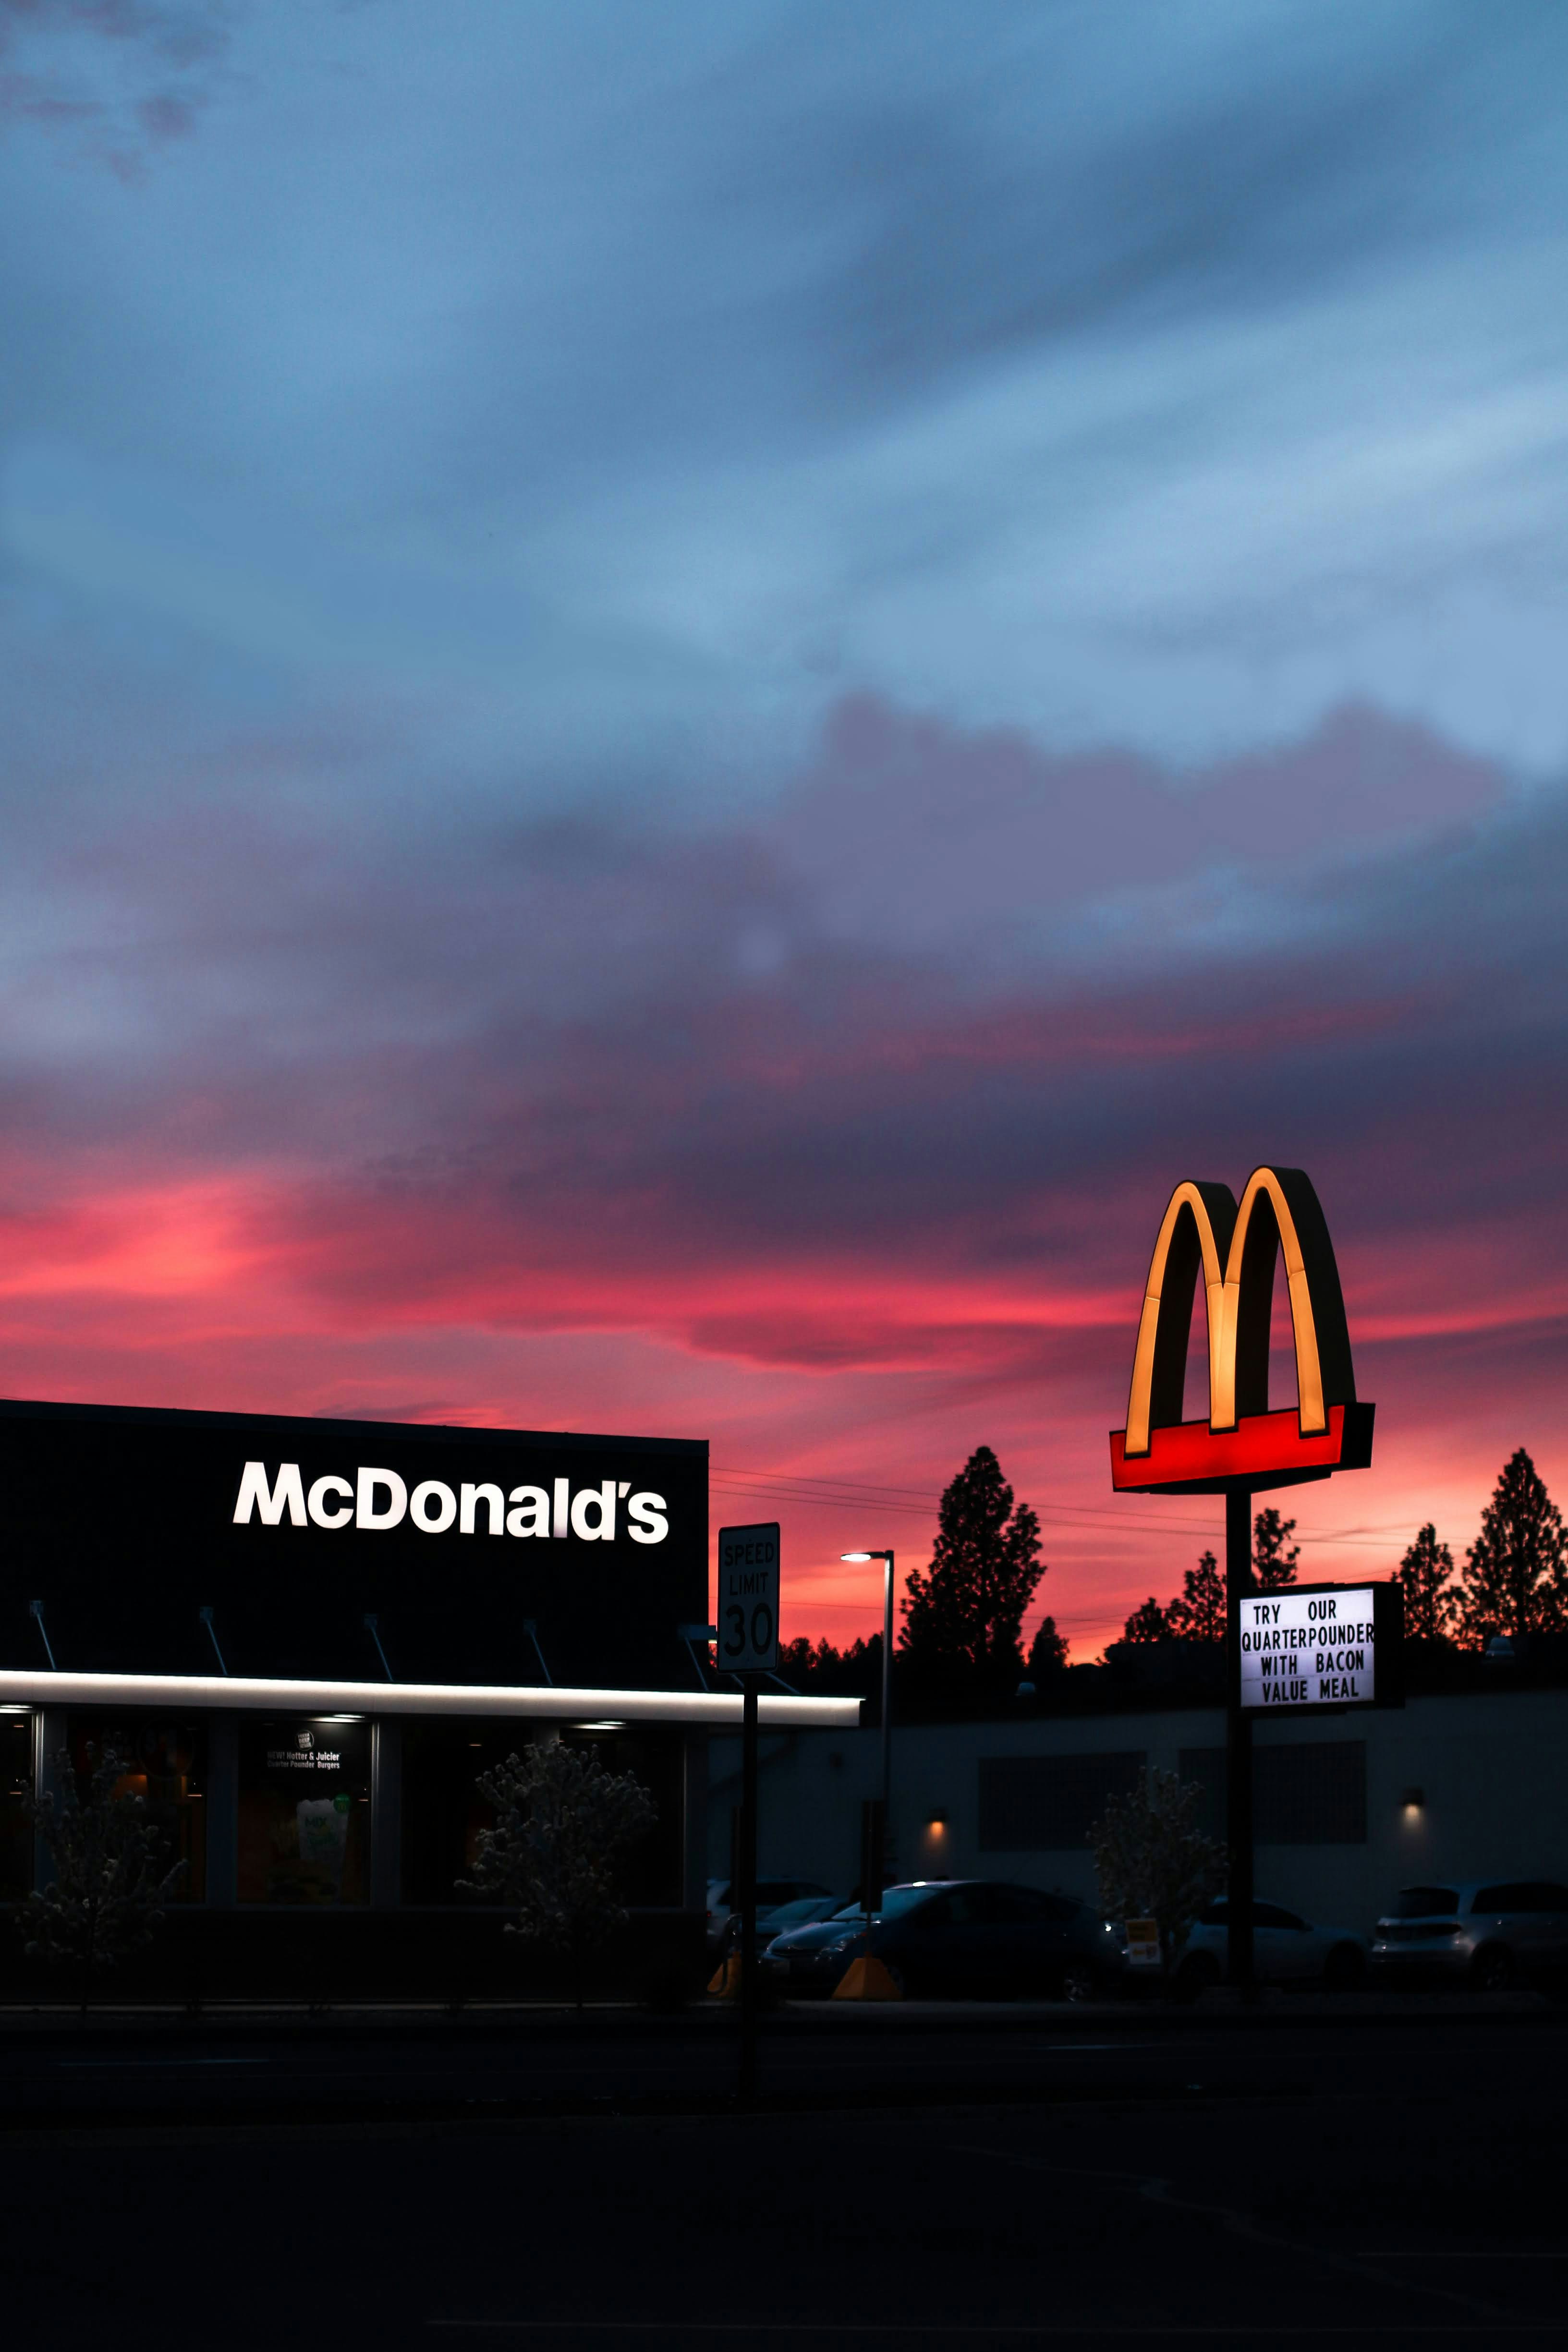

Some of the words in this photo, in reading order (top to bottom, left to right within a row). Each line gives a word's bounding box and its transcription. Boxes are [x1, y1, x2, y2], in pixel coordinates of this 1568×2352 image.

[232, 1461, 669, 1544] McDonald's
[724, 1541, 774, 1566] SPEED
[729, 1572, 769, 1596] LIMIT
[1253, 1604, 1281, 1625] TRY
[1308, 1600, 1337, 1621] OUR
[724, 1602, 773, 1656] 30
[1242, 1623, 1374, 1652] QUARTERPOUNDER
[1261, 1655, 1297, 1676] WITH
[1316, 1650, 1364, 1673] BACON
[1263, 1680, 1307, 1703] VALUE
[1320, 1677, 1359, 1699] MEAL
[287, 1751, 308, 1760] Hotter
[309, 1751, 315, 1761] &
[316, 1751, 340, 1761] Juicier
[290, 1760, 315, 1769] Pounder
[317, 1761, 340, 1770] Burgers
